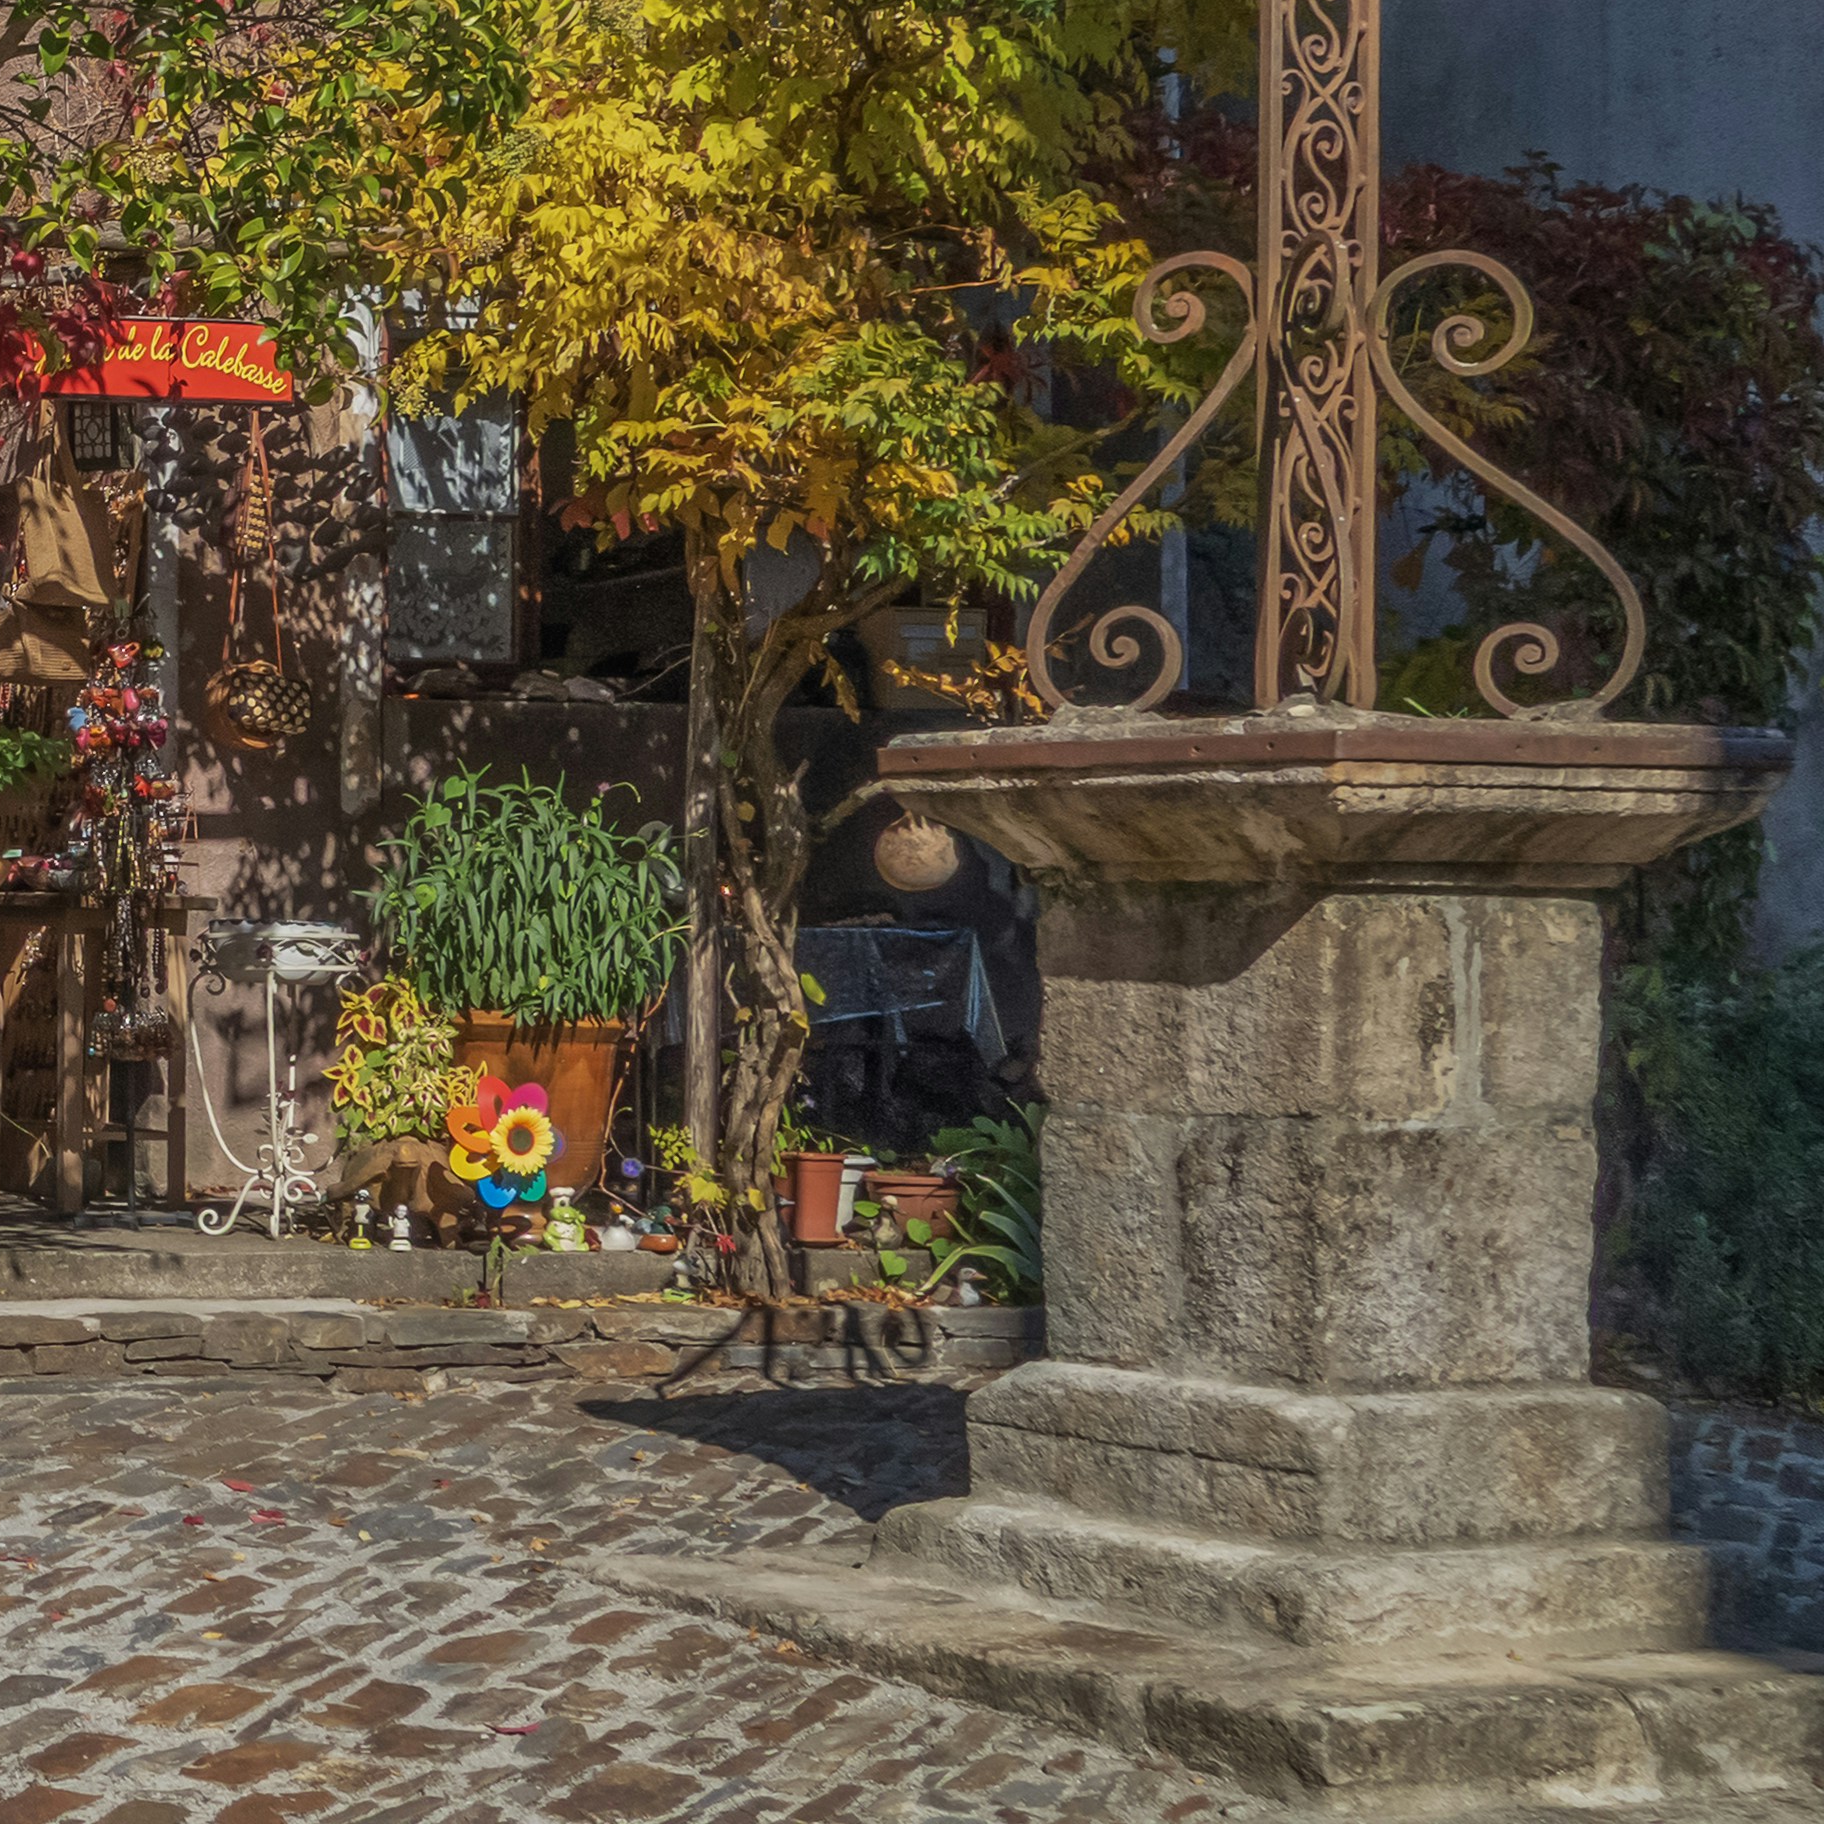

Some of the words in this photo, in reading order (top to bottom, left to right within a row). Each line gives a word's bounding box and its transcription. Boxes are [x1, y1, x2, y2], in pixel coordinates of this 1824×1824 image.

[118, 325, 147, 361] de
[150, 325, 176, 361] la
[181, 324, 287, 395] Calebasse
